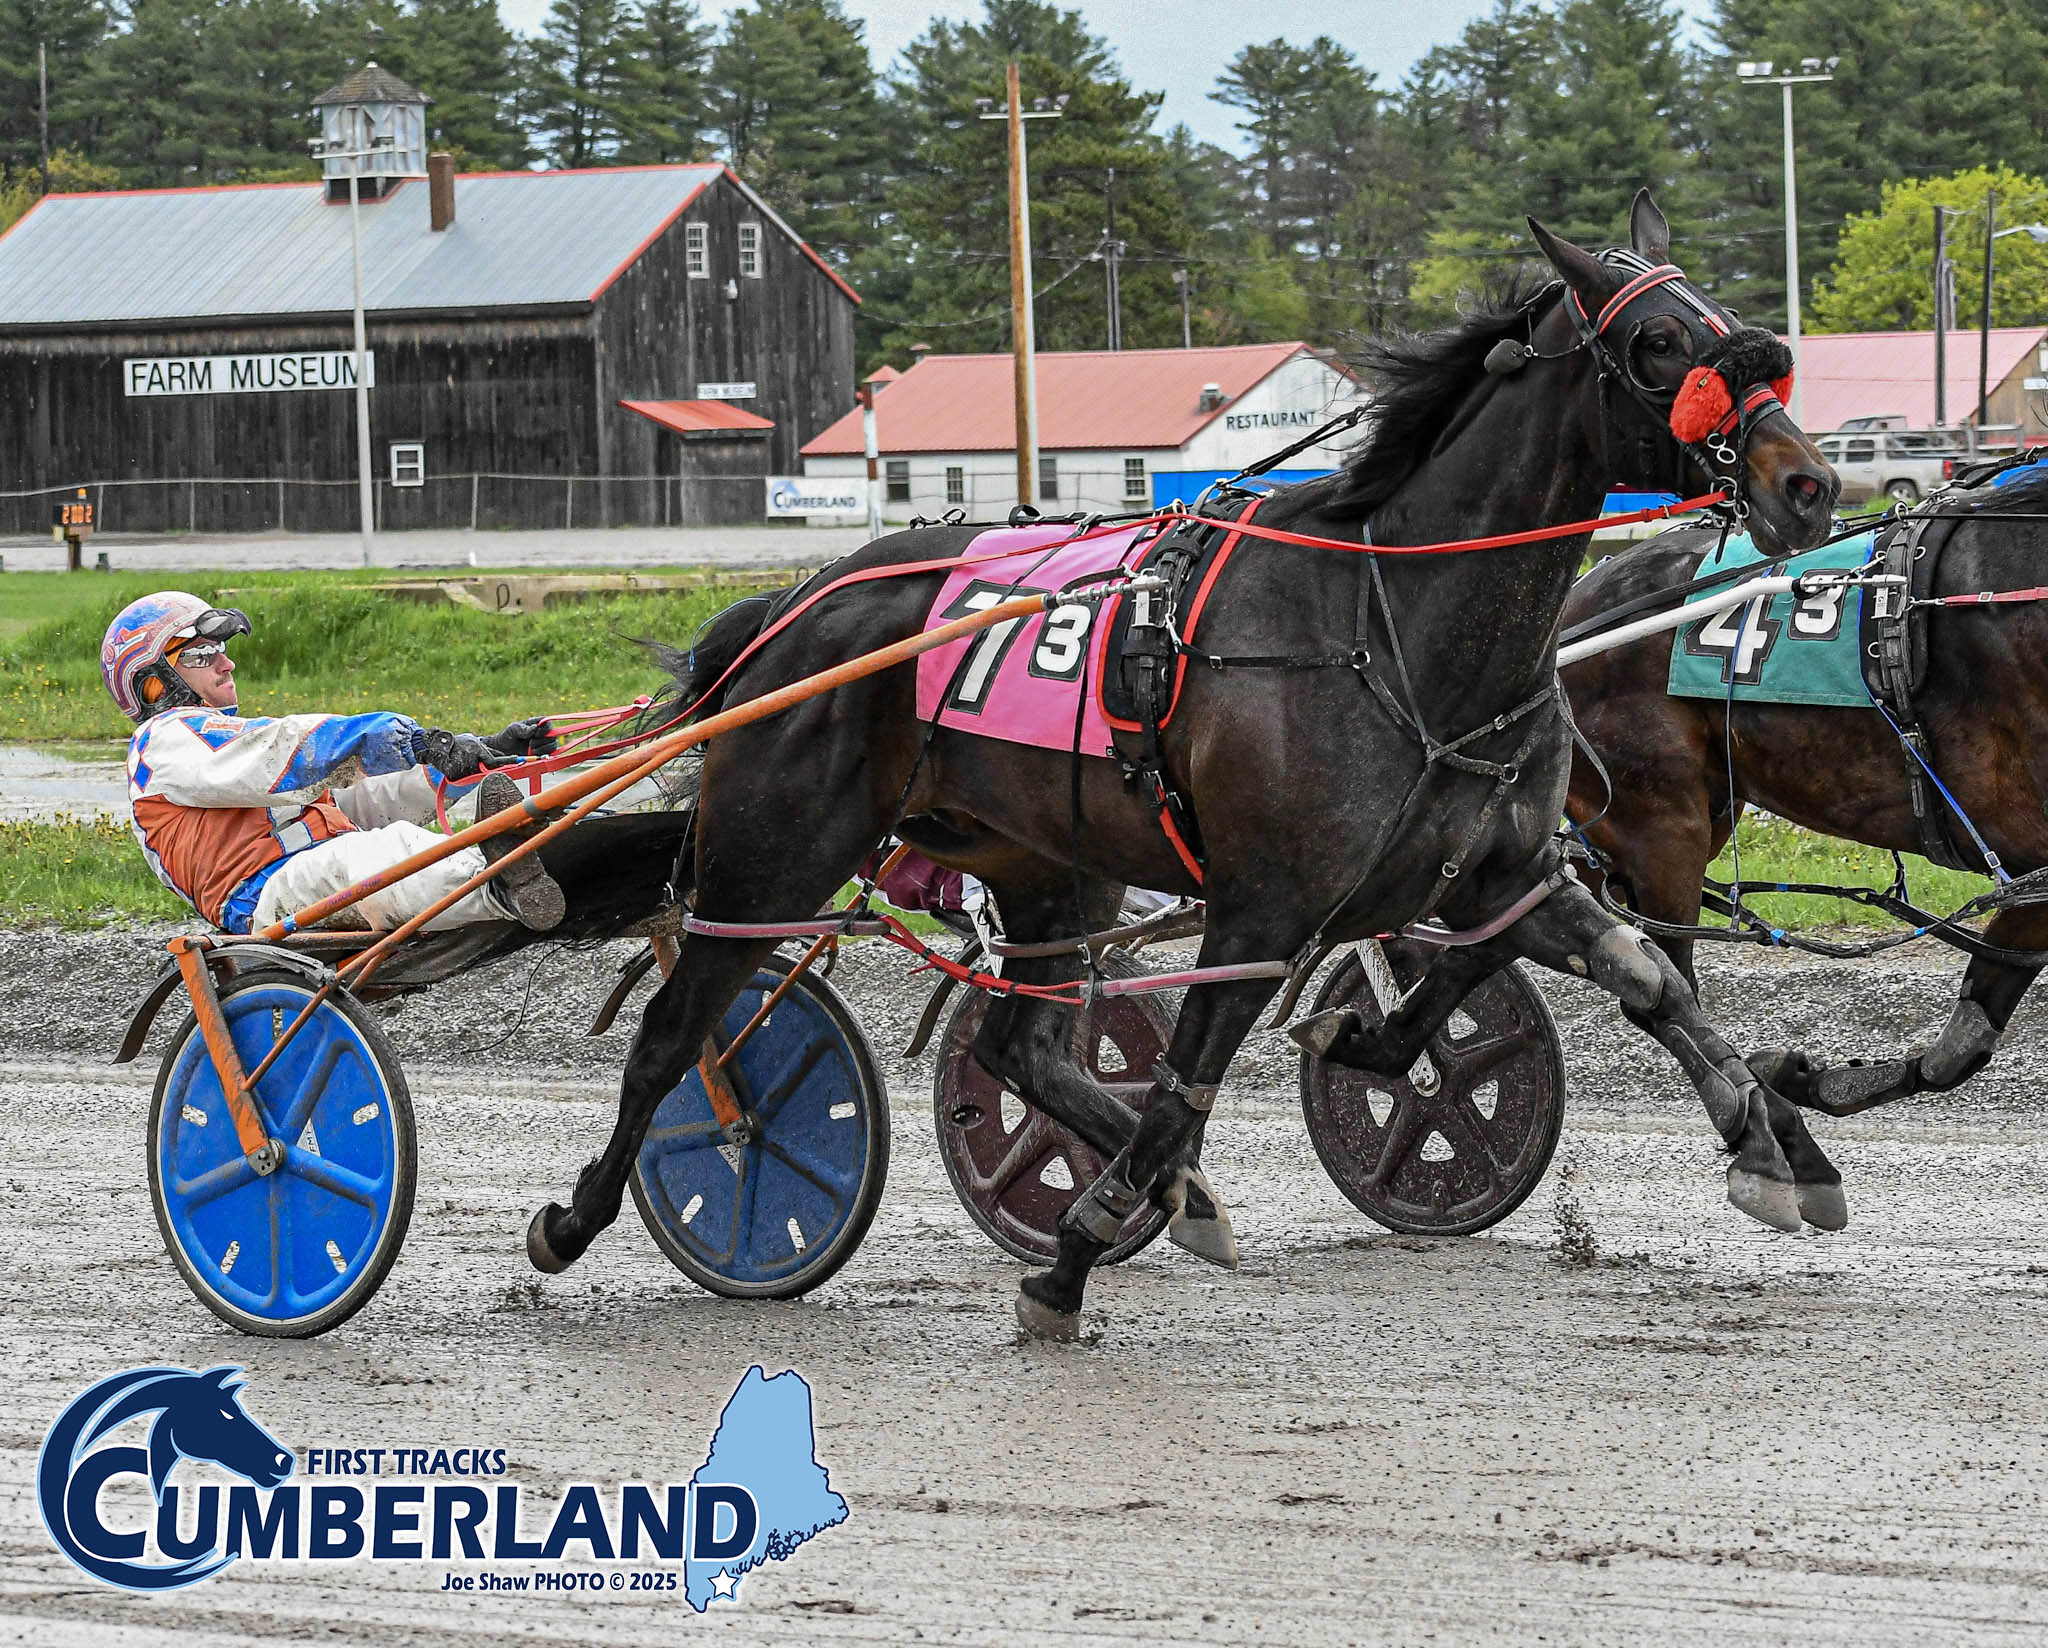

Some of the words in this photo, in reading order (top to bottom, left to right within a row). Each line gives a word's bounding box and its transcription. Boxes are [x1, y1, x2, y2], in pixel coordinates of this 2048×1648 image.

[131, 361, 213, 393] FARM
[230, 355, 361, 389] MUSEUM
[1226, 411, 1316, 431] RESTAURANT
[956, 590, 1036, 703] 7
[1035, 602, 1092, 673] 3
[1699, 586, 1768, 674] 4
[1794, 573, 1844, 634] 3
